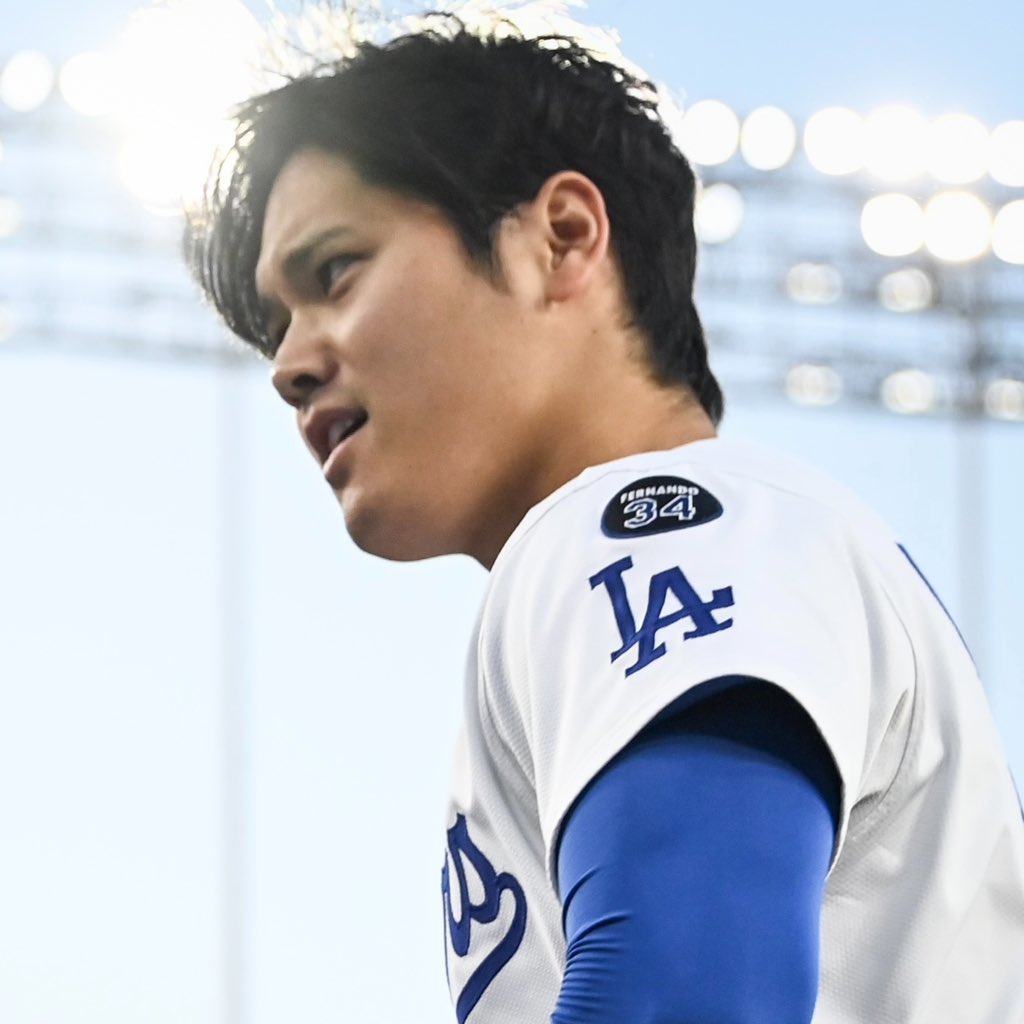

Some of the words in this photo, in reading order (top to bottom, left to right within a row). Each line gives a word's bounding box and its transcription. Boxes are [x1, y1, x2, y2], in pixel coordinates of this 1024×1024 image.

[619, 484, 700, 504] FERNANDO
[622, 494, 697, 529] 34
[588, 555, 736, 678] LA
